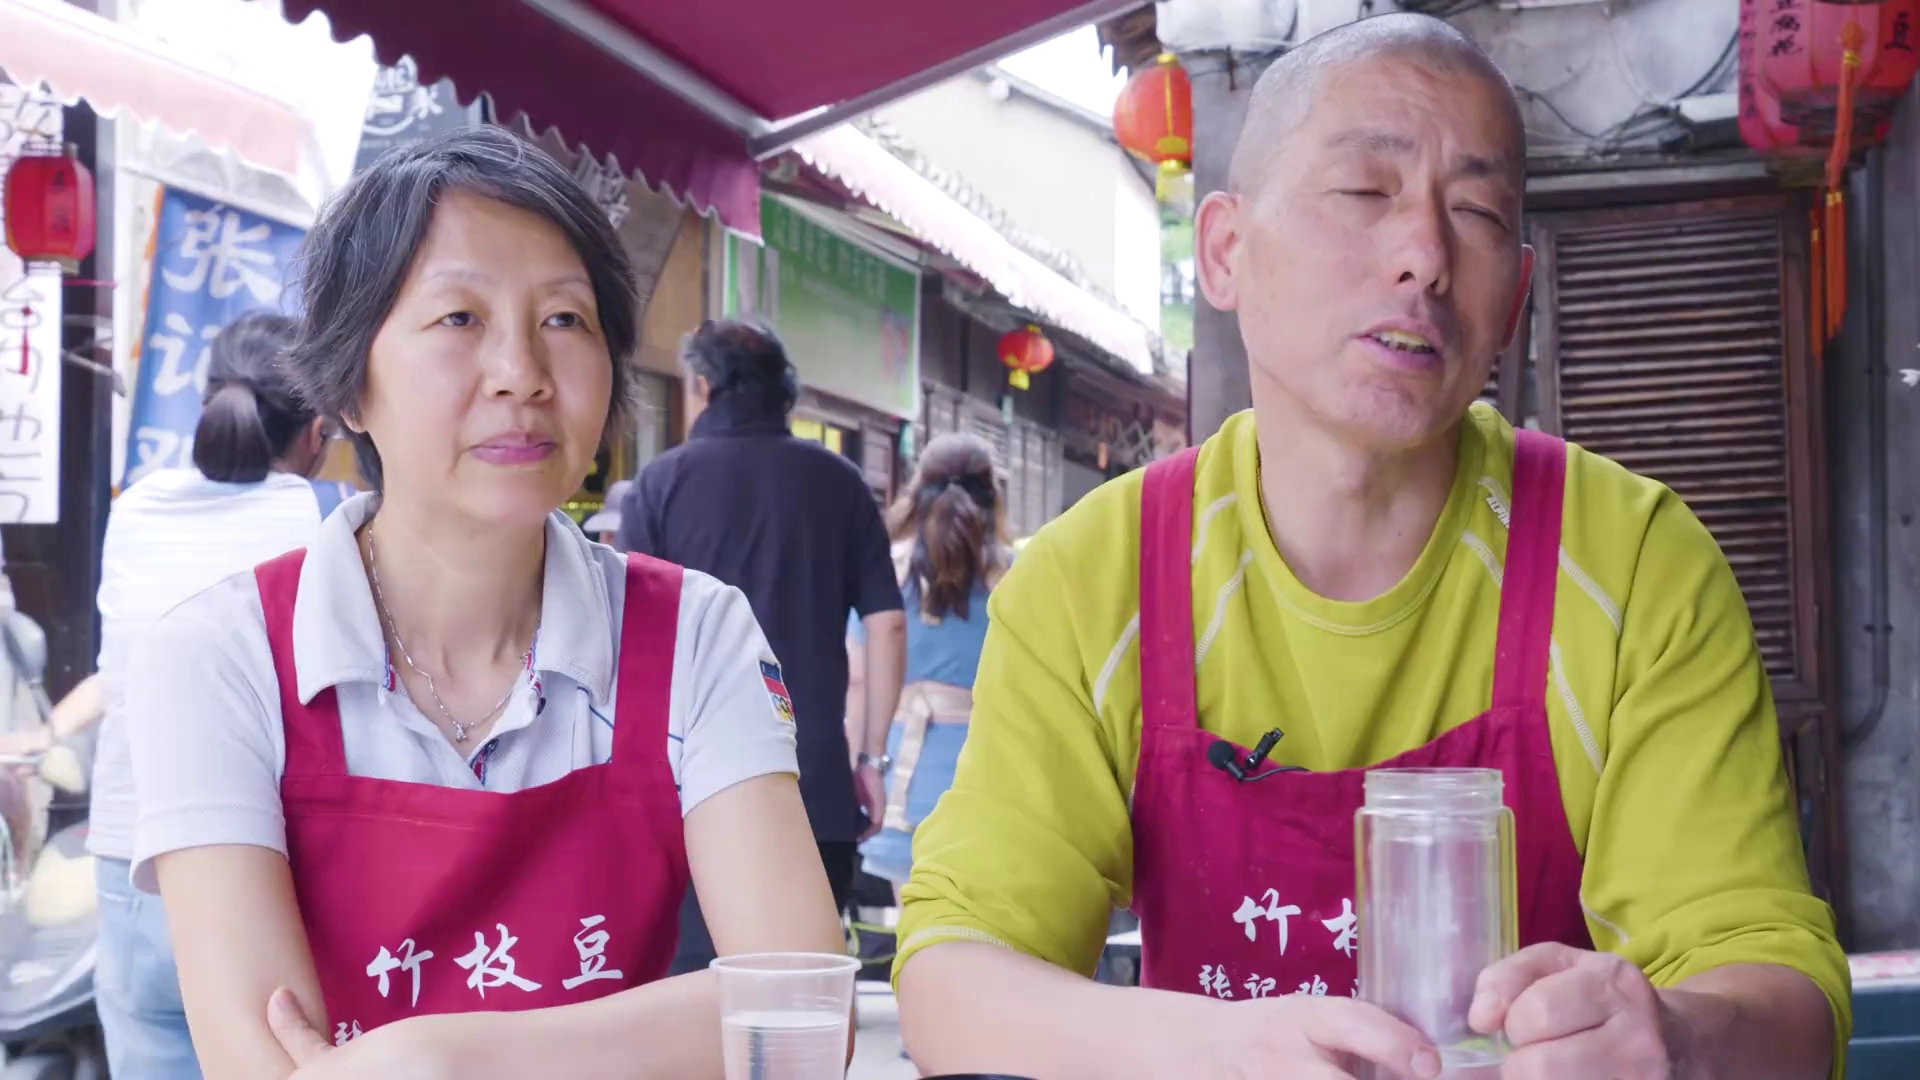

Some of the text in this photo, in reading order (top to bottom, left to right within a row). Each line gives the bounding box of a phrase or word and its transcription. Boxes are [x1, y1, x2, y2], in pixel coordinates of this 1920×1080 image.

[366, 914, 624, 1008] 竹枝豆
[1199, 963, 1358, 1000] 张记鸡
